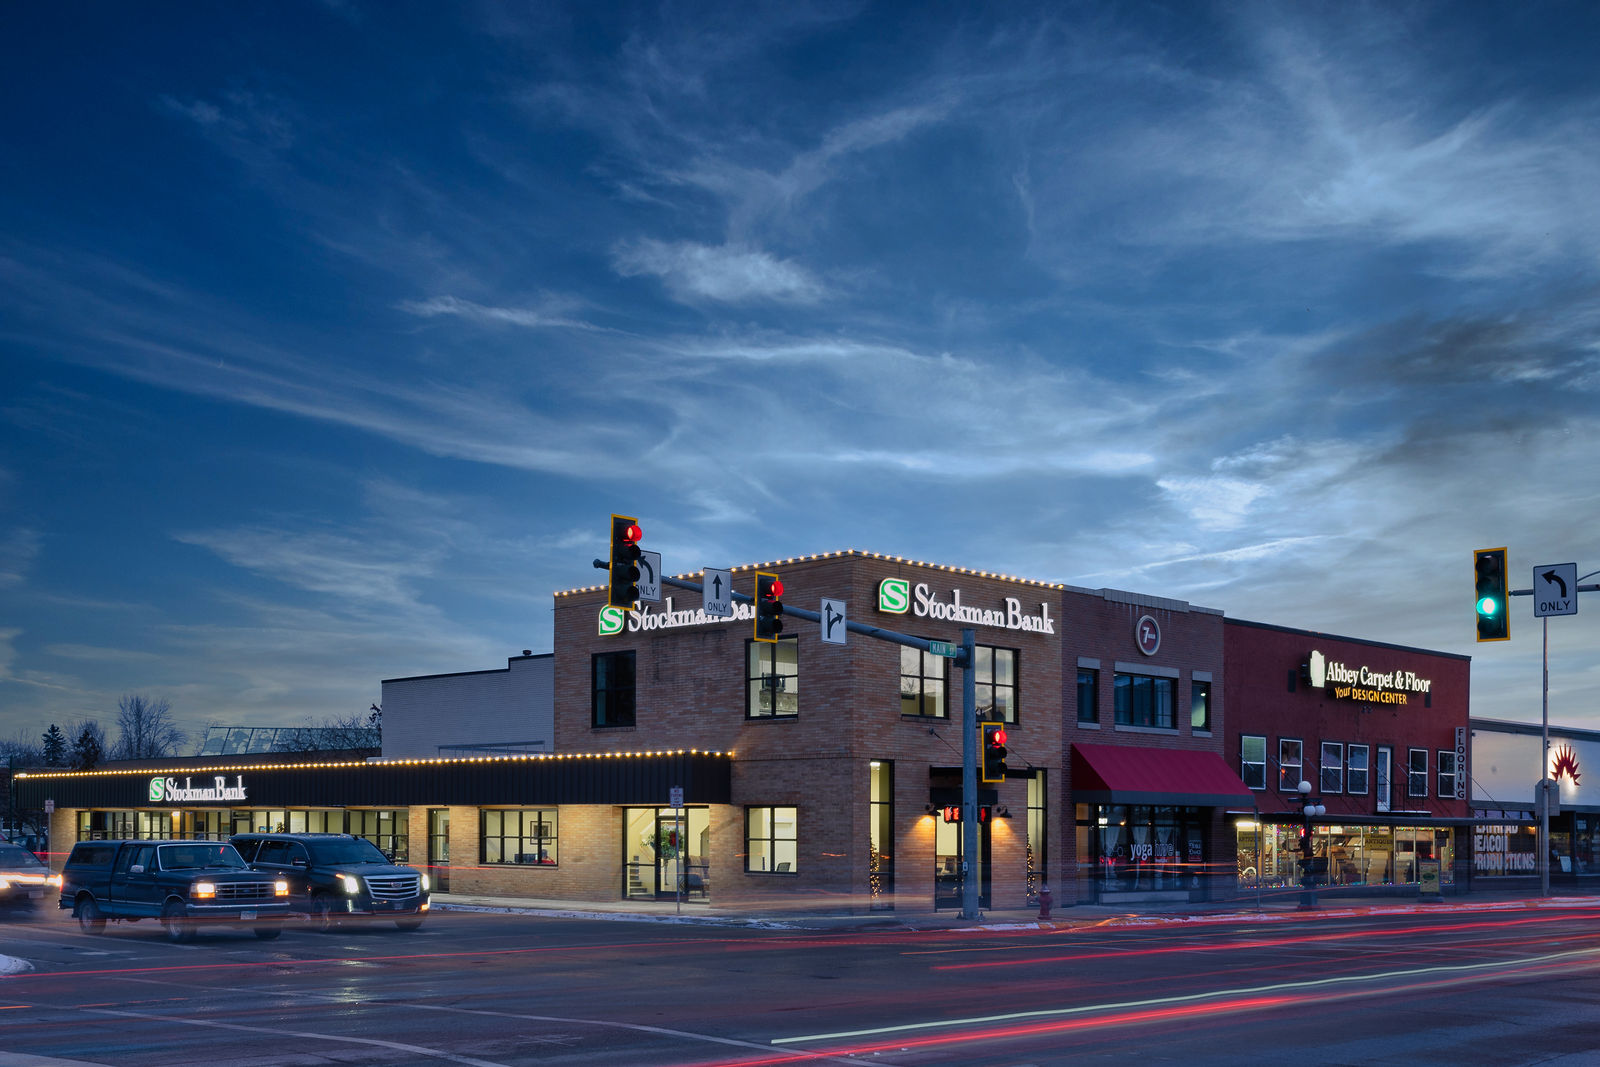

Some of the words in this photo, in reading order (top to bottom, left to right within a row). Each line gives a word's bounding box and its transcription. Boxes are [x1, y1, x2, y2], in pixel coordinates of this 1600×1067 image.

[707, 602, 727, 613] ONLY
[914, 583, 1005, 628] Stockman
[1006, 597, 1055, 634] Bank
[1540, 601, 1570, 612] ONLY
[932, 642, 946, 654] MAIN
[1326, 662, 1359, 687] Abbey
[1360, 666, 1393, 691] Carpet
[1395, 671, 1404, 690] &
[1405, 671, 1431, 693] Floor
[1335, 687, 1351, 699] Your
[1352, 688, 1380, 702] DESIGN
[1380, 691, 1407, 705] CENTER
[1457, 728, 1465, 799] FLOORING
[1474, 835, 1508, 852] EACON
[1130, 844, 1153, 861] yoga
